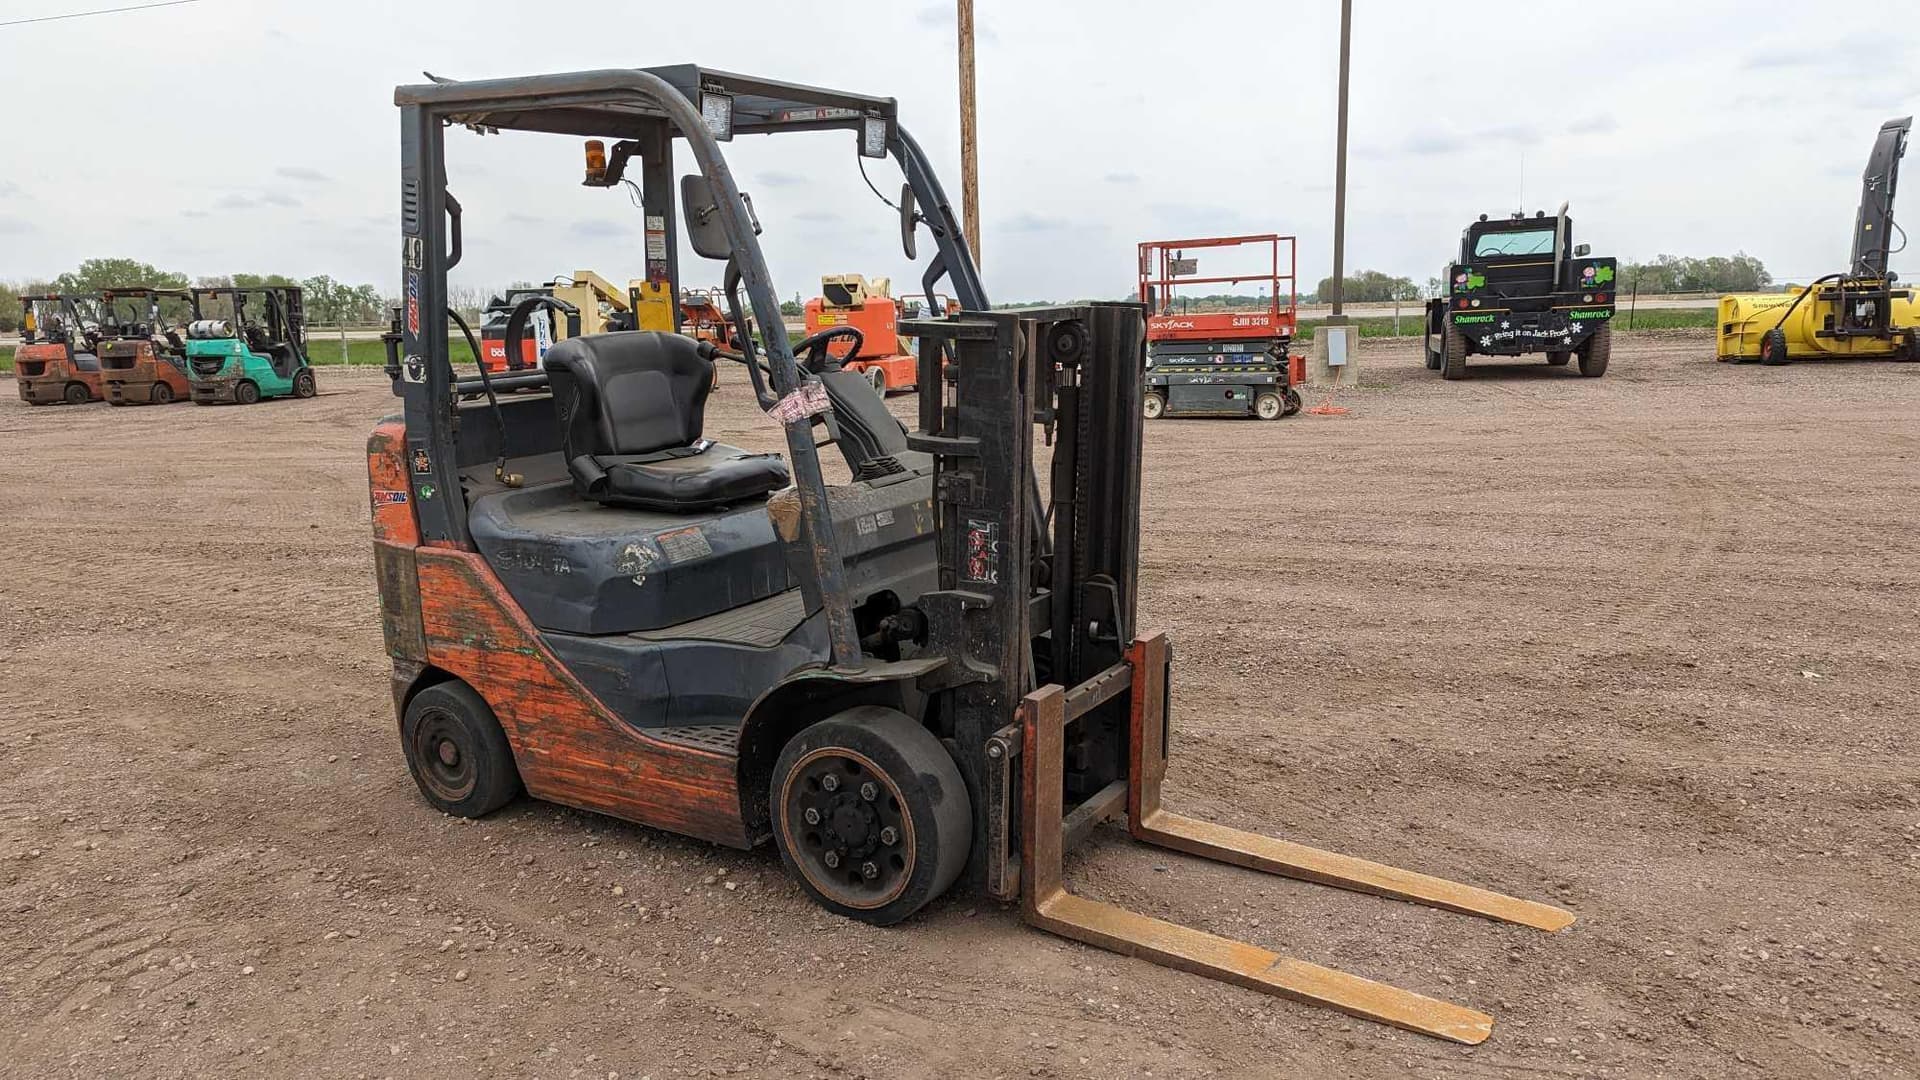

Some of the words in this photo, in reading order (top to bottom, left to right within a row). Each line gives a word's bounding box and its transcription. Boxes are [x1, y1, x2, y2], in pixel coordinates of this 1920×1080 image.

[1455, 314, 1495, 324] Shamrock
[1569, 310, 1610, 319] Shamrock
[1151, 319, 1194, 329] SKYJACK
[1251, 317, 1269, 326] 3219
[374, 491, 407, 503] AMSOIL
